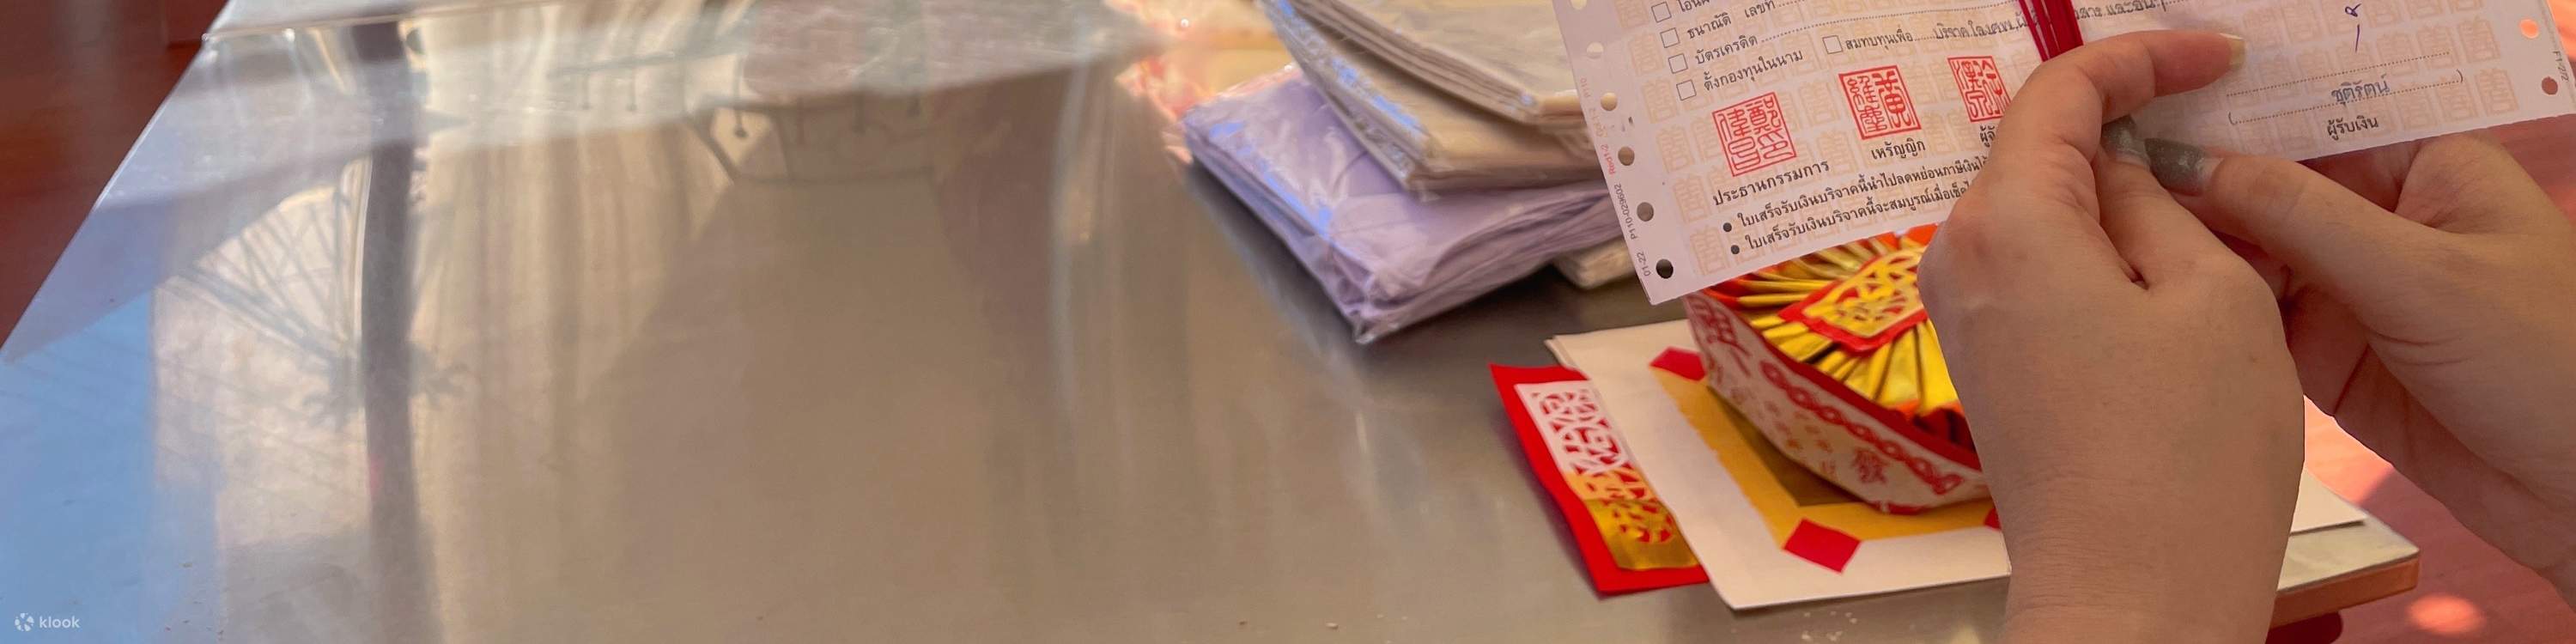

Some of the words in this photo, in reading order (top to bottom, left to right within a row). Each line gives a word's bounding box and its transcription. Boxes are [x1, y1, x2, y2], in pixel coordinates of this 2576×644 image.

[1695, 35, 1758, 64] บัตรเครดิต
[1704, 50, 1803, 91] ตั้งกองทุนในนาม
[2327, 115, 2379, 141] ผู้รับเงิน
[1871, 137, 1926, 160] เหรัญญิก
[1712, 161, 1830, 206] ประธานกรรมการ
